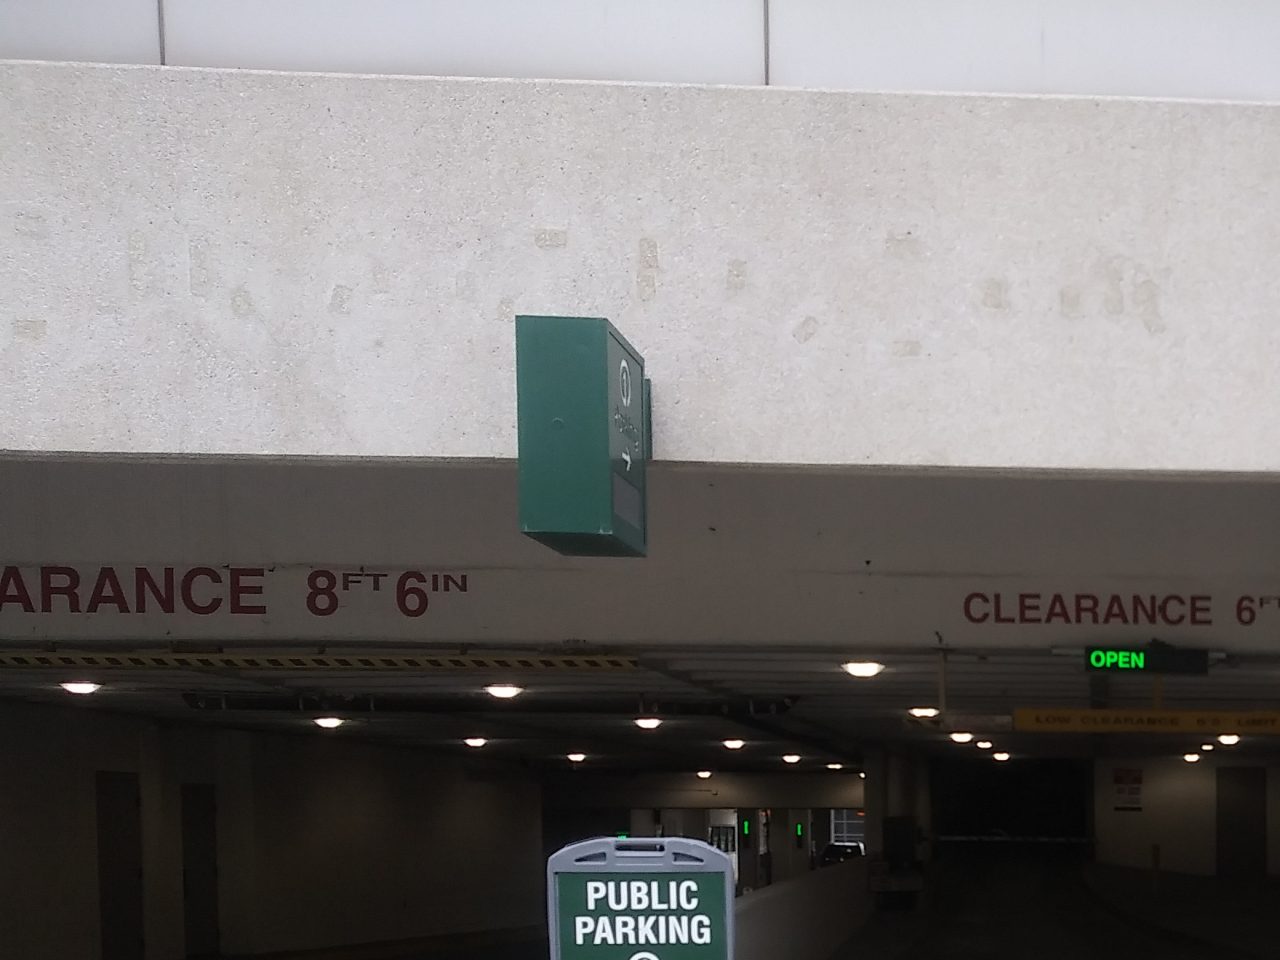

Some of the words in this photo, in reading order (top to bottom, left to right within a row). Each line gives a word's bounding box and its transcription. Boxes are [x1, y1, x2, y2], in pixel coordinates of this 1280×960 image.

[963, 592, 1213, 626] CLEARANCE
[1089, 650, 1146, 670] OPEN
[1035, 715, 1070, 725] LOW
[1080, 715, 1180, 726] CLEARANCE
[585, 880, 699, 911] PUBLIC
[575, 915, 712, 945] PARKING
